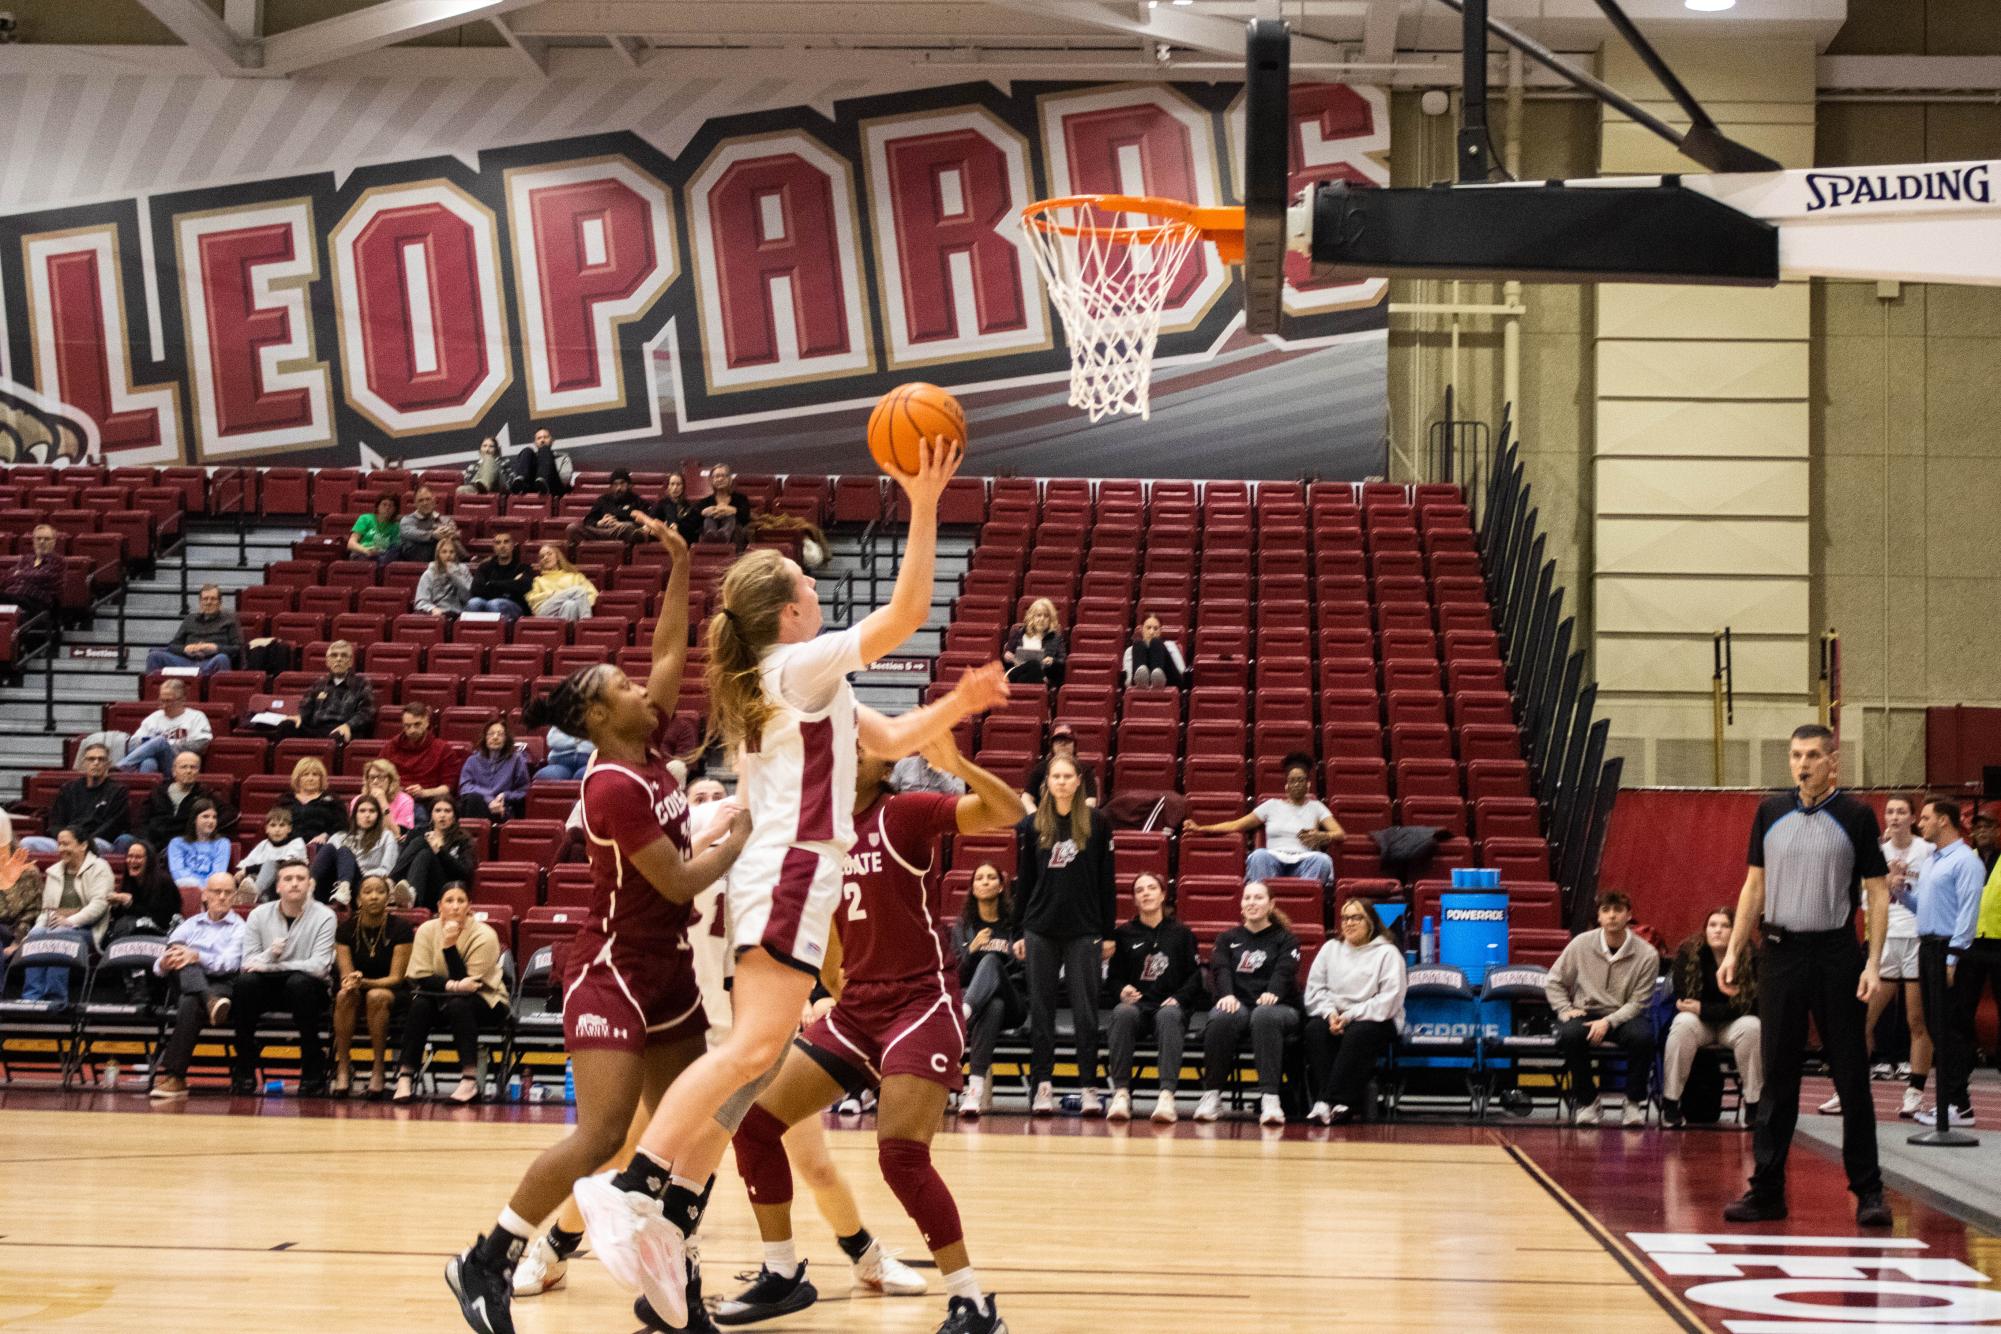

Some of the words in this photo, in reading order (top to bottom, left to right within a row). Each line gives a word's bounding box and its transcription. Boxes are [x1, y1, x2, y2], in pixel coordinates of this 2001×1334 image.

[1805, 163, 1991, 212] SPALDING
[870, 660, 904, 671] Section
[842, 881, 868, 922] 2
[1446, 908, 1505, 921] POWERADE
[930, 1052, 949, 1074] C
[1625, 1232, 2001, 1334] LEO
